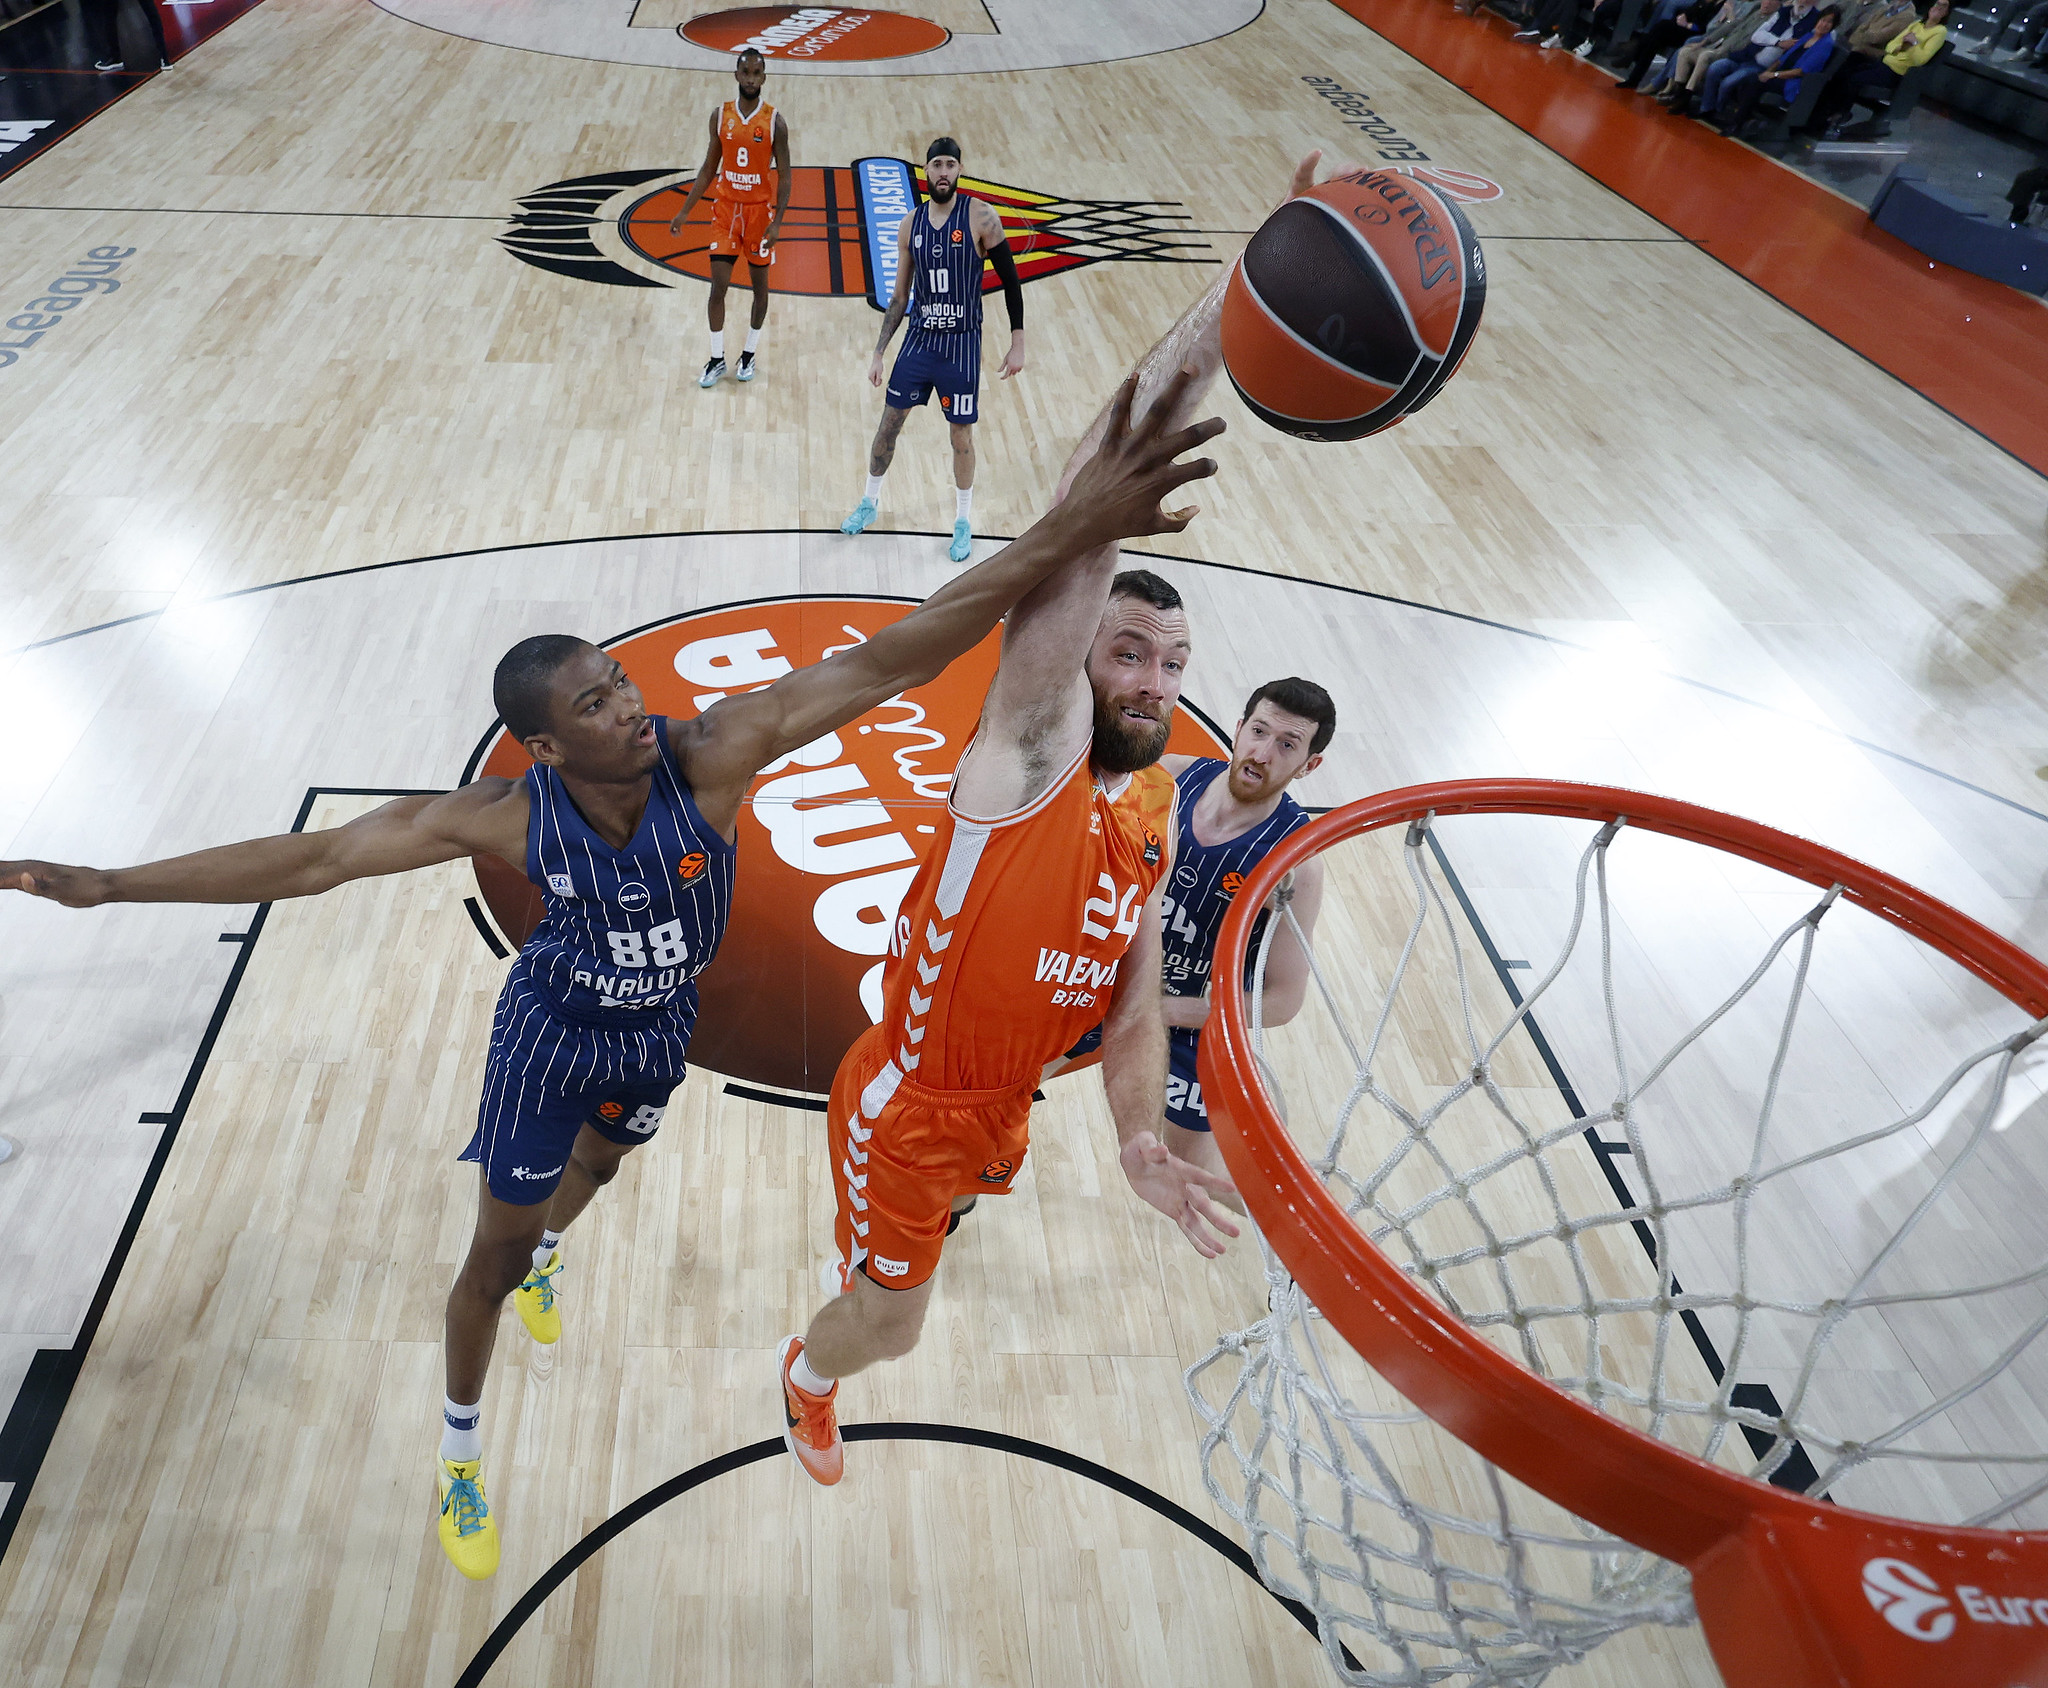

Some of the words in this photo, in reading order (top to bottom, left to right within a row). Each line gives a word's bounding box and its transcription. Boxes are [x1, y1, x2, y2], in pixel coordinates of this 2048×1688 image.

[730, 8, 843, 55] PAMESA
[725, 170, 762, 185] VALENCIA
[736, 147, 749, 168] 8
[867, 163, 909, 215] BASKET
[1323, 171, 1457, 290] SPALDIN
[928, 268, 949, 293] 10
[923, 316, 957, 330] EFES
[953, 393, 974, 416] 10
[1081, 871, 1143, 947] 24
[1161, 895, 1198, 944] 24
[607, 917, 689, 968] 88
[1166, 1073, 1208, 1117] 24
[876, 1259, 906, 1271] PULEVA
